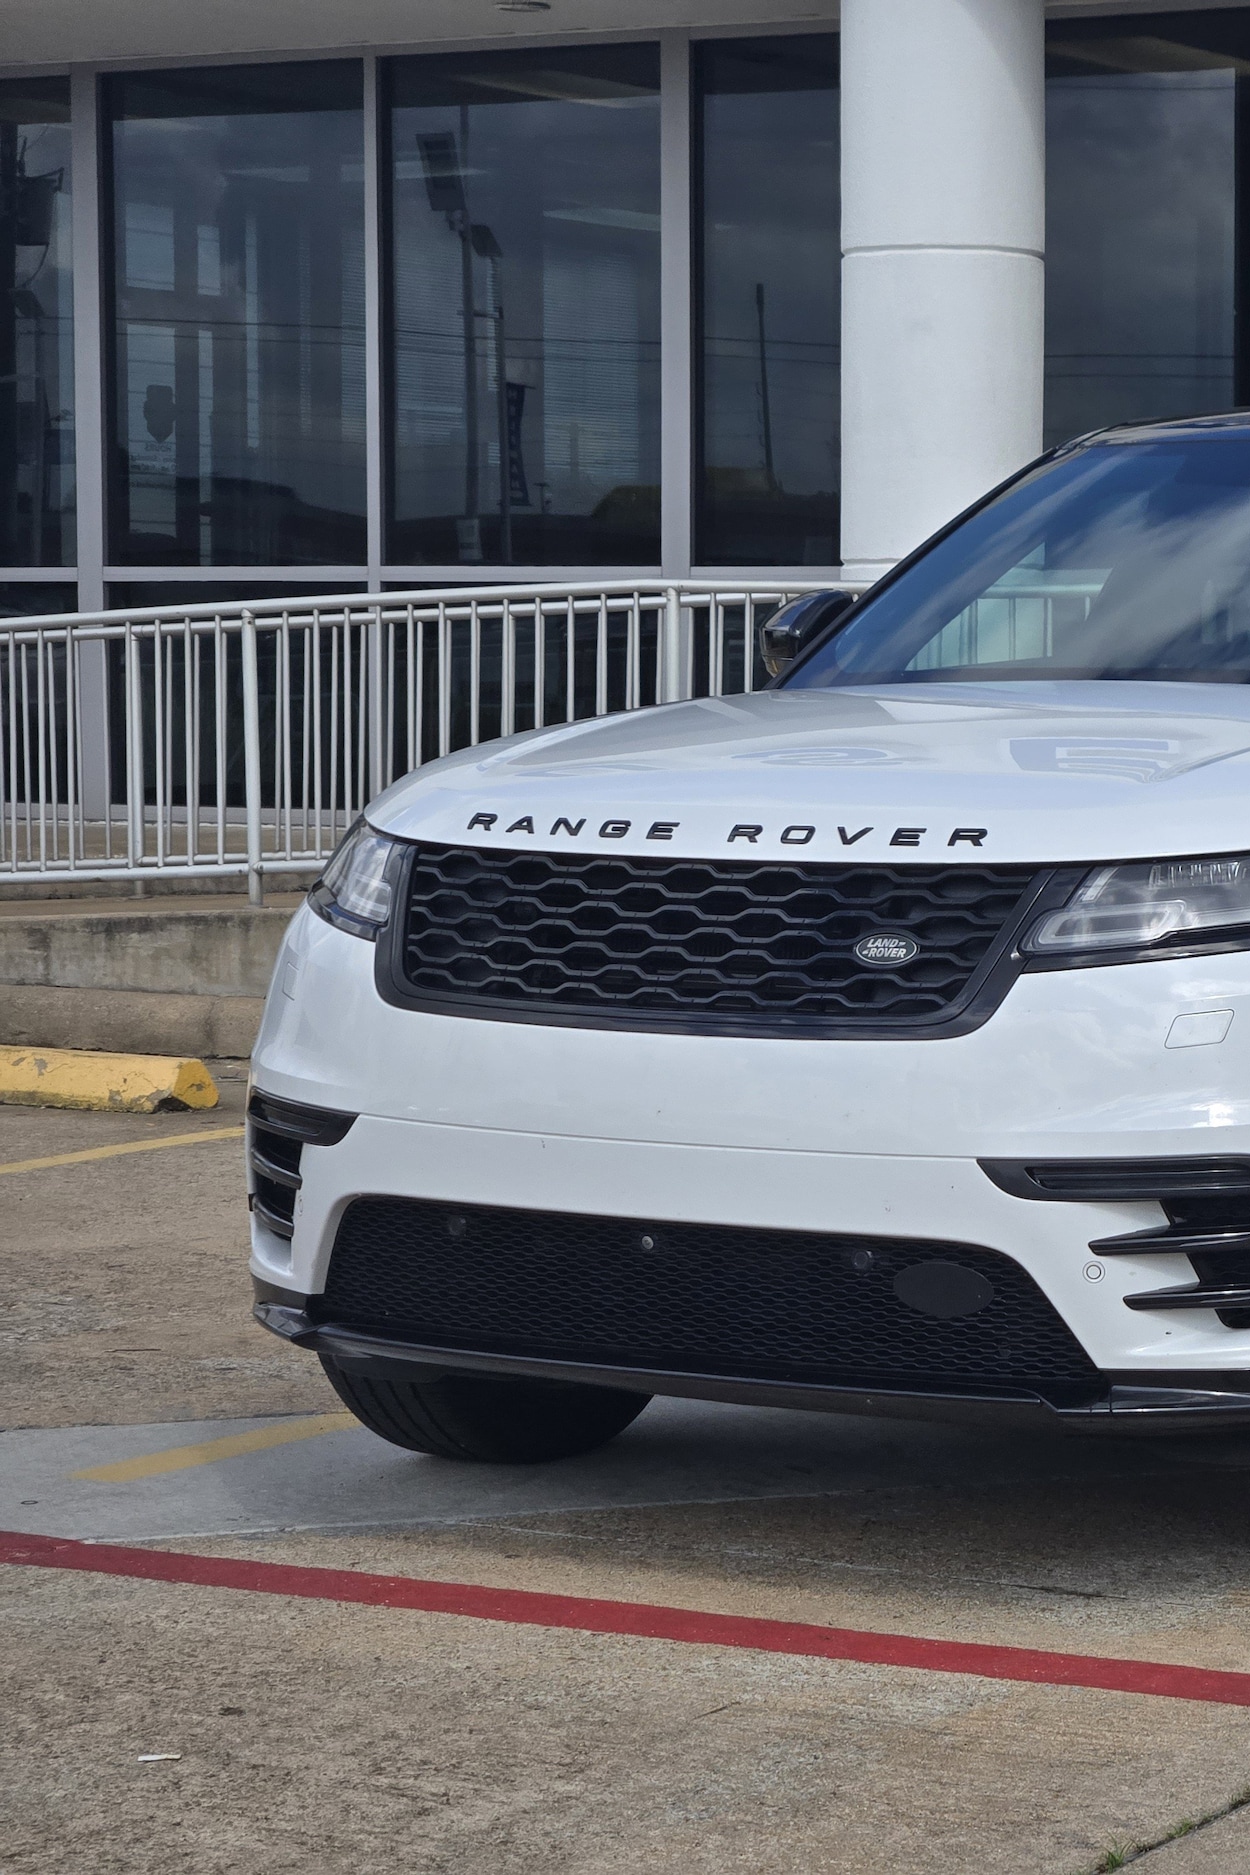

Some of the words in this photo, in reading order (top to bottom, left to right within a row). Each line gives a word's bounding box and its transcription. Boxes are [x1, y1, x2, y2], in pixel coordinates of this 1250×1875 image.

[467, 812, 680, 841] RANGE
[728, 823, 988, 848] ROVER
[867, 938, 899, 947] LAND
[868, 948, 907, 958] ROVER
